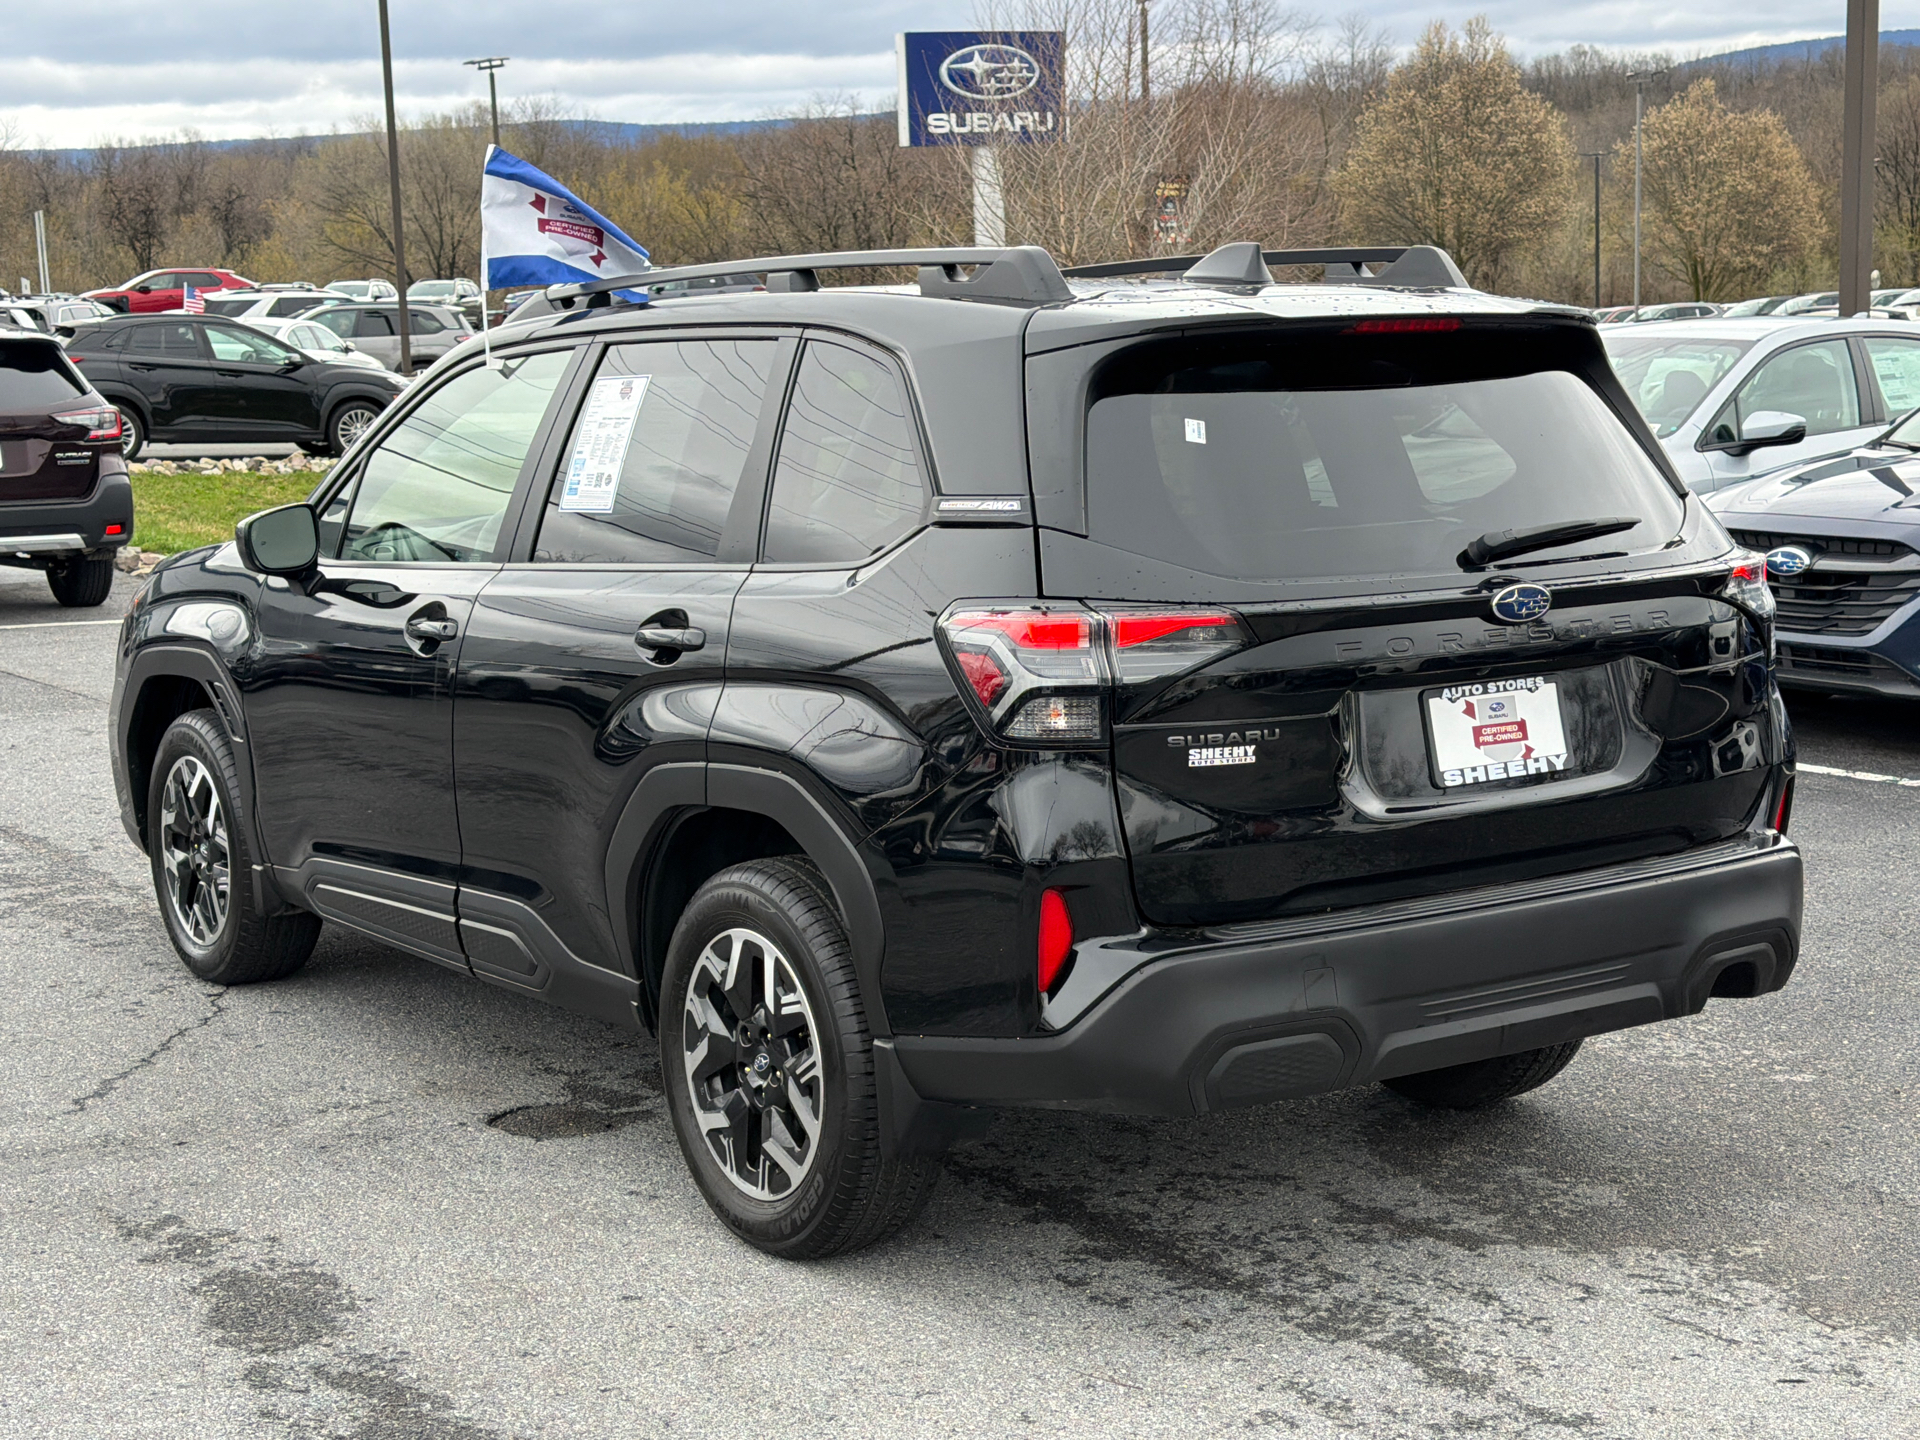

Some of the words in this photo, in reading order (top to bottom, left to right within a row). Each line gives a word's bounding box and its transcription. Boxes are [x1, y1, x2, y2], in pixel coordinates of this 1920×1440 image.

[927, 111, 1053, 135] SUBARU
[559, 213, 586, 222] SUBARU
[545, 225, 598, 243] PRE-OWNED
[549, 220, 595, 234] CERTIFIED
[1335, 609, 1673, 662] FORESTER
[1441, 683, 1483, 700] AUTO
[1487, 676, 1545, 693] STORES
[1488, 712, 1509, 720] SUBARU
[1479, 731, 1523, 743] PRE-OWNED
[1481, 724, 1518, 735] CERTIFIED
[1167, 728, 1280, 748] SUBARU
[1188, 745, 1256, 760] SHEEHY
[1443, 753, 1568, 787] SHEEHY
